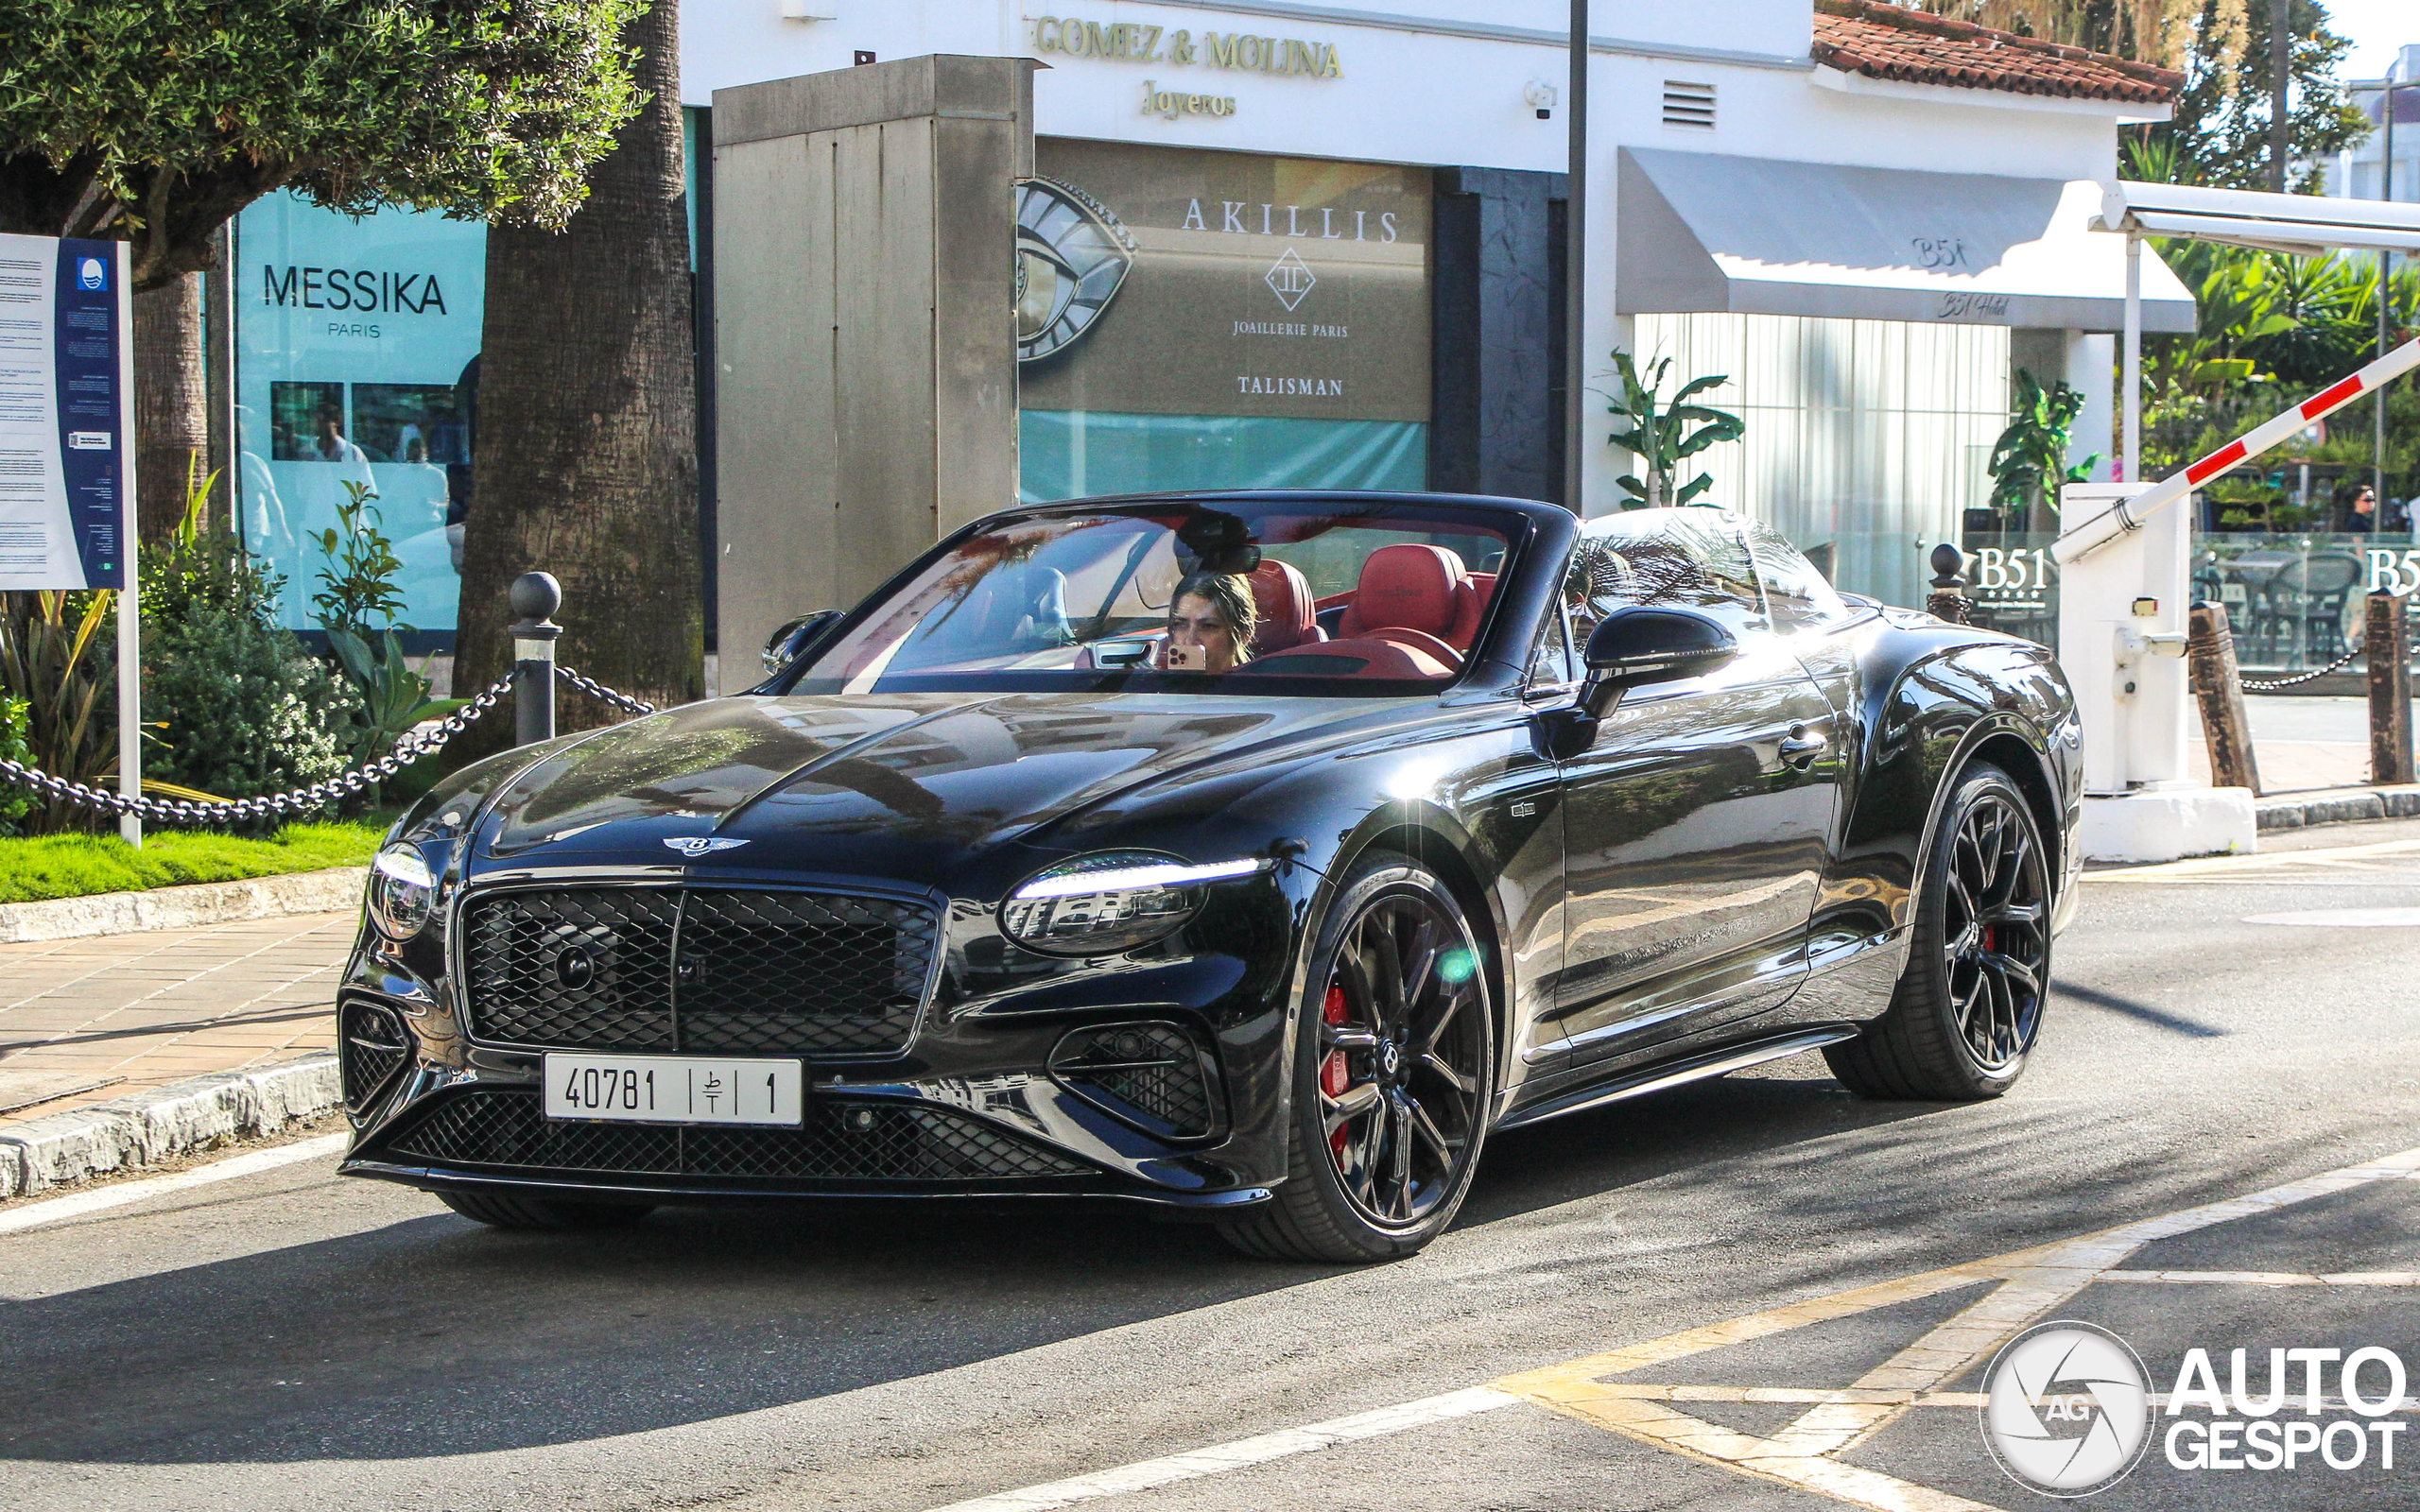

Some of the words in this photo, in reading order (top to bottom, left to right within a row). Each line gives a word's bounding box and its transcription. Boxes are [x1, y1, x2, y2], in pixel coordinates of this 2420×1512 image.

[1037, 16, 1164, 62] GOMEZ
[1174, 29, 1198, 64] &
[1206, 31, 1344, 78] MOLINA
[1143, 79, 1236, 120] Joyeros
[1182, 198, 1397, 244] AKILLIS
[264, 264, 447, 316] MESSIKA
[328, 322, 381, 338] PARIS
[1233, 320, 1307, 336] JOAILLERIE
[1312, 325, 1349, 338] PARIS
[1237, 376, 1343, 396] TALISMAN
[1975, 547, 2048, 590] B51
[565, 1068, 654, 1110] 40781
[766, 1073, 775, 1114] 1
